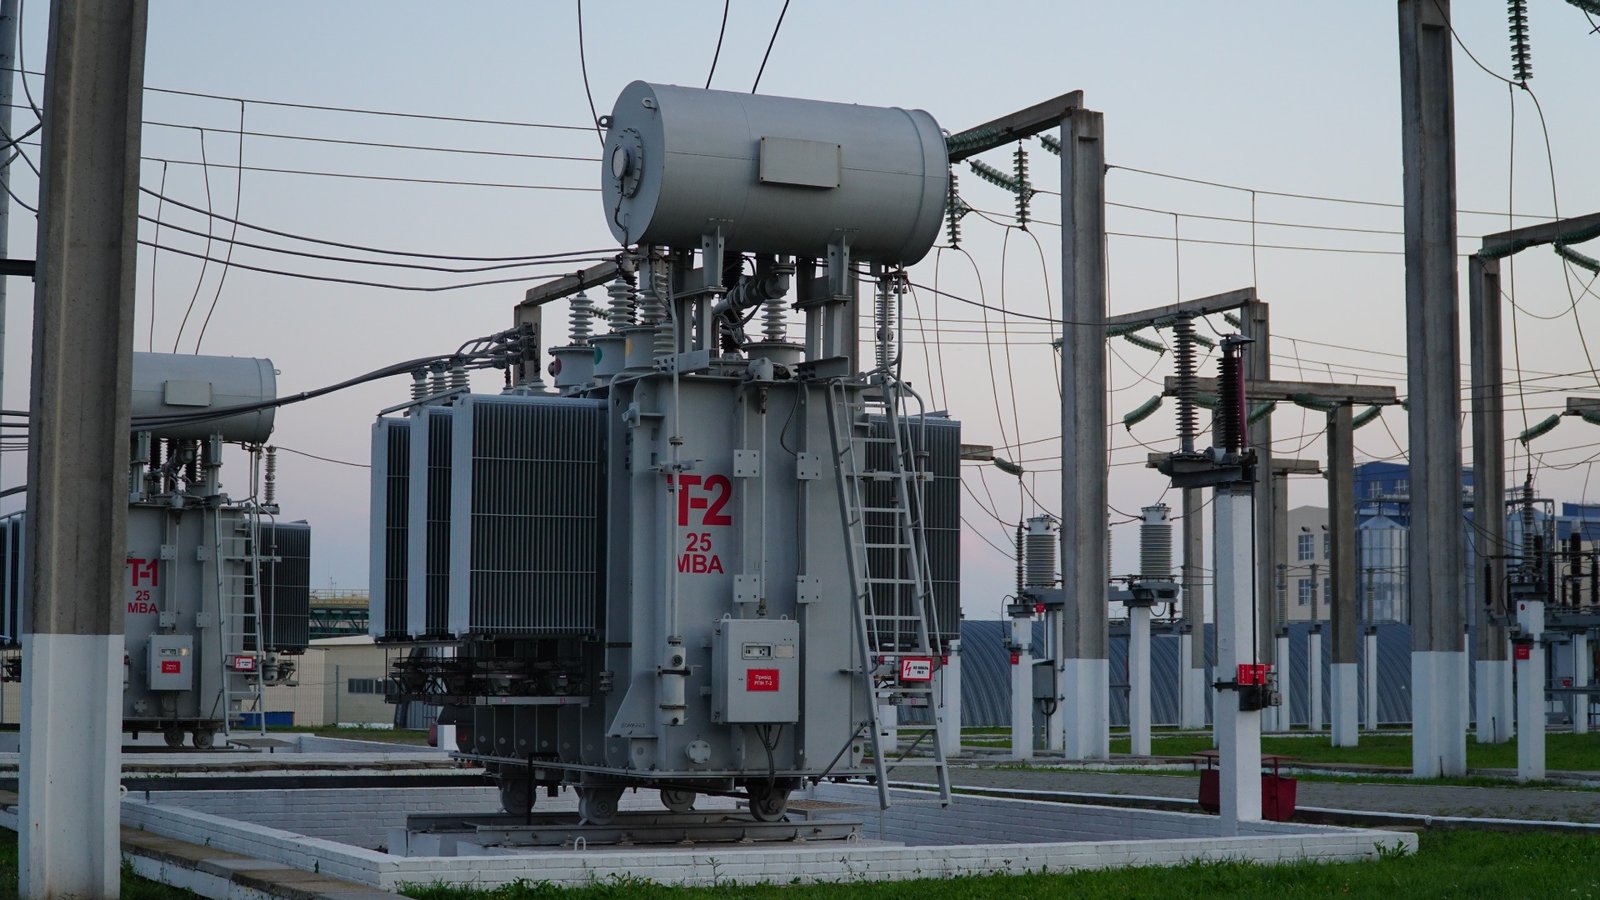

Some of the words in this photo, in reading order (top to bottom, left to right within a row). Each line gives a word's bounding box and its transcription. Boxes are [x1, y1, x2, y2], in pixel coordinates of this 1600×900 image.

[667, 474, 732, 526] Т-2
[686, 532, 712, 552] 25
[127, 559, 158, 586] Т-1
[136, 591, 150, 601] 25
[128, 603, 158, 613] МВА
